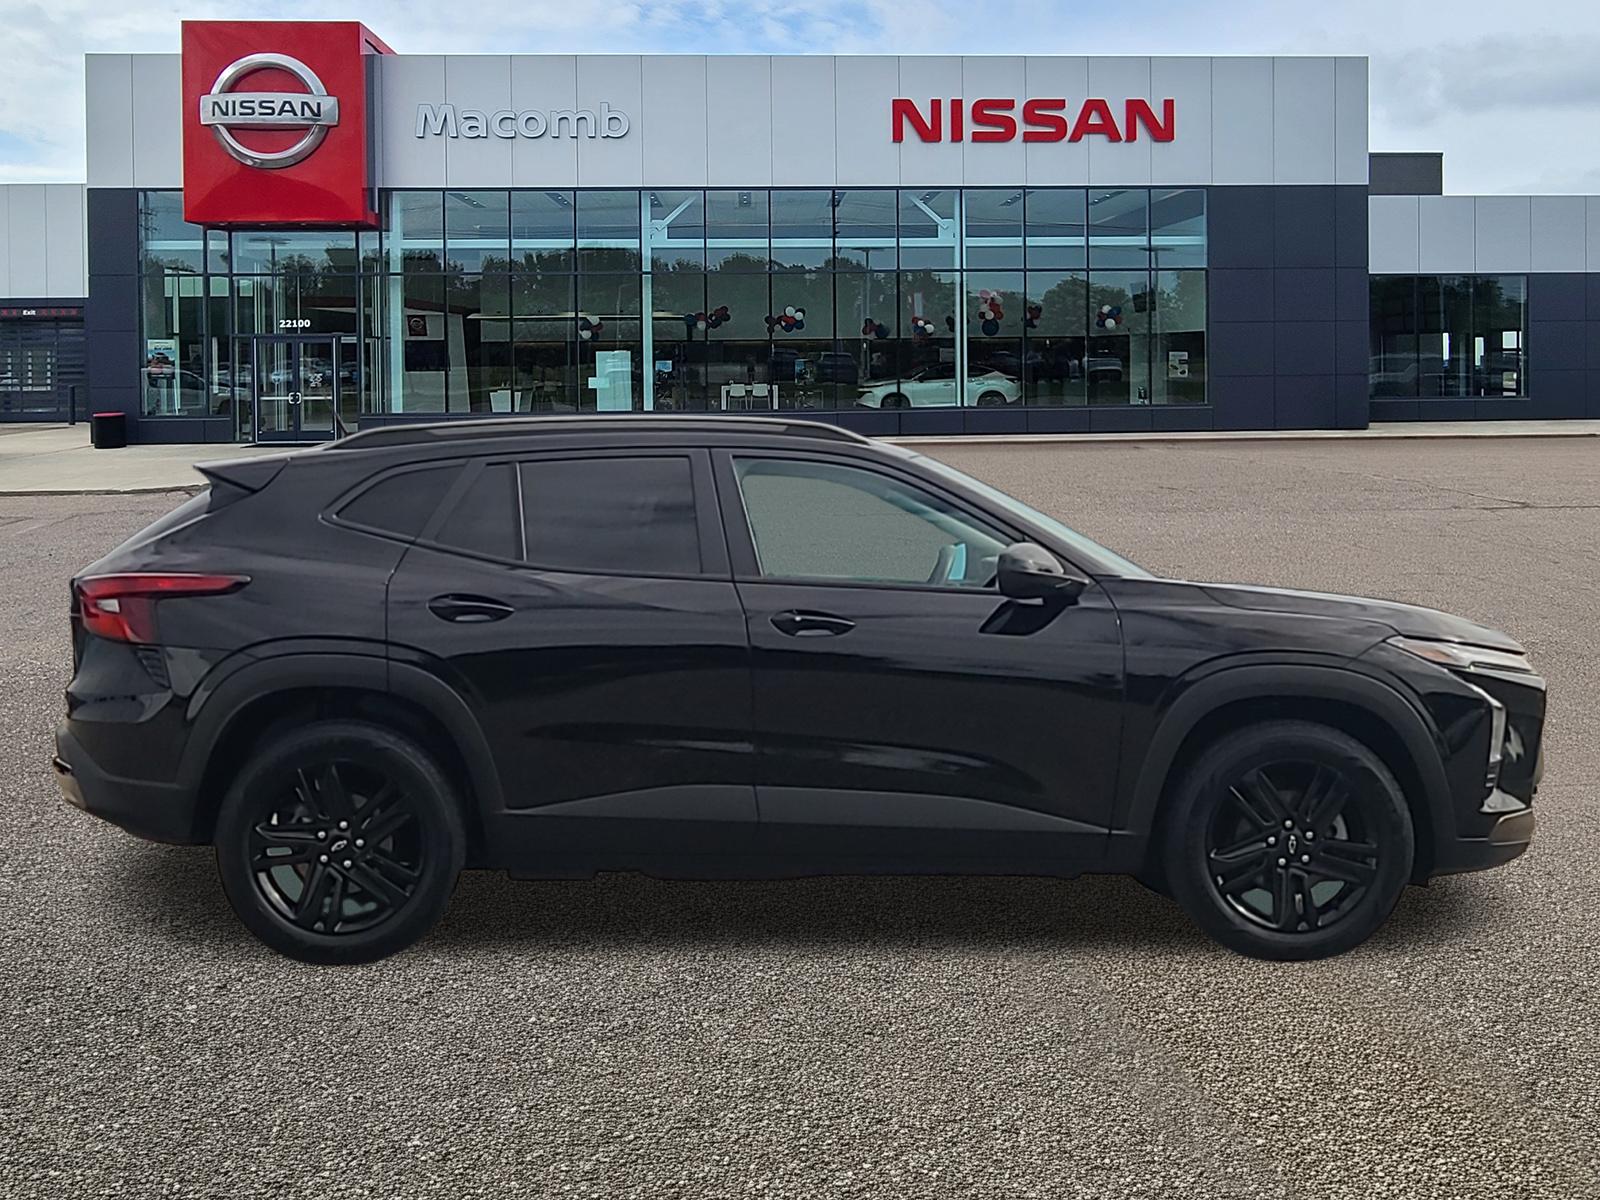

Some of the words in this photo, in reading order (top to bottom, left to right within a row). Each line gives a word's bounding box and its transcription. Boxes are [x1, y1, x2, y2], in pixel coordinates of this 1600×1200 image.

[211, 99, 322, 118] NISSAN
[414, 101, 631, 139] Macomb
[891, 98, 1176, 144] NISSAN
[279, 319, 311, 328] 22100
